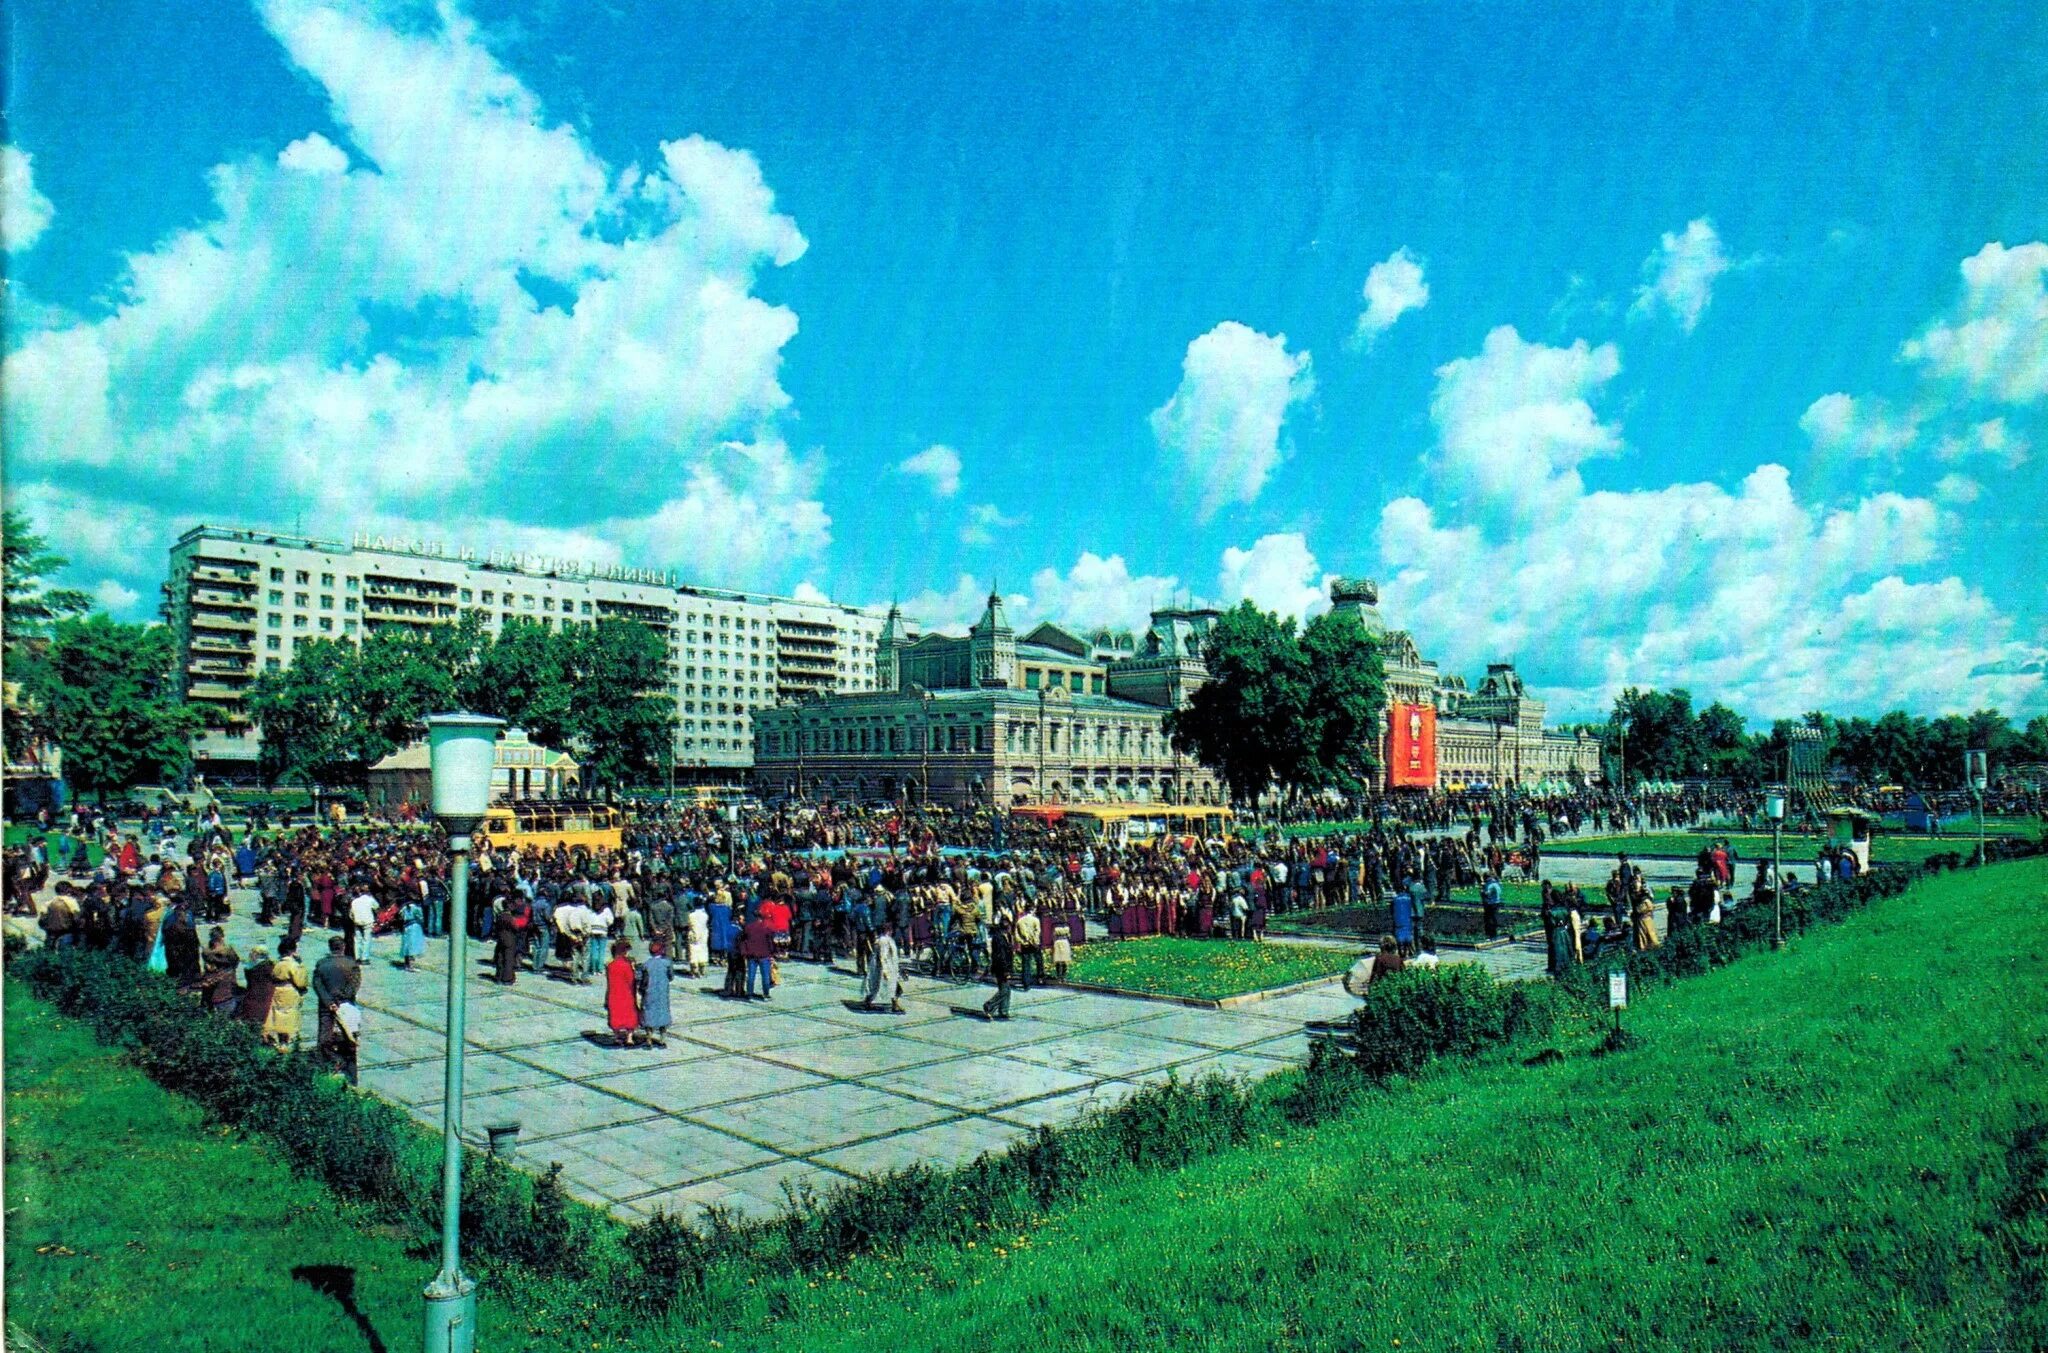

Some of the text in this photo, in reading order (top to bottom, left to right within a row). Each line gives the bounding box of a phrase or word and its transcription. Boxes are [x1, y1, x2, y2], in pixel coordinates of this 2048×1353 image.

[353, 531, 443, 557] НАРОД
[459, 543, 475, 561] И
[489, 549, 580, 574] ПАРТИЯ
